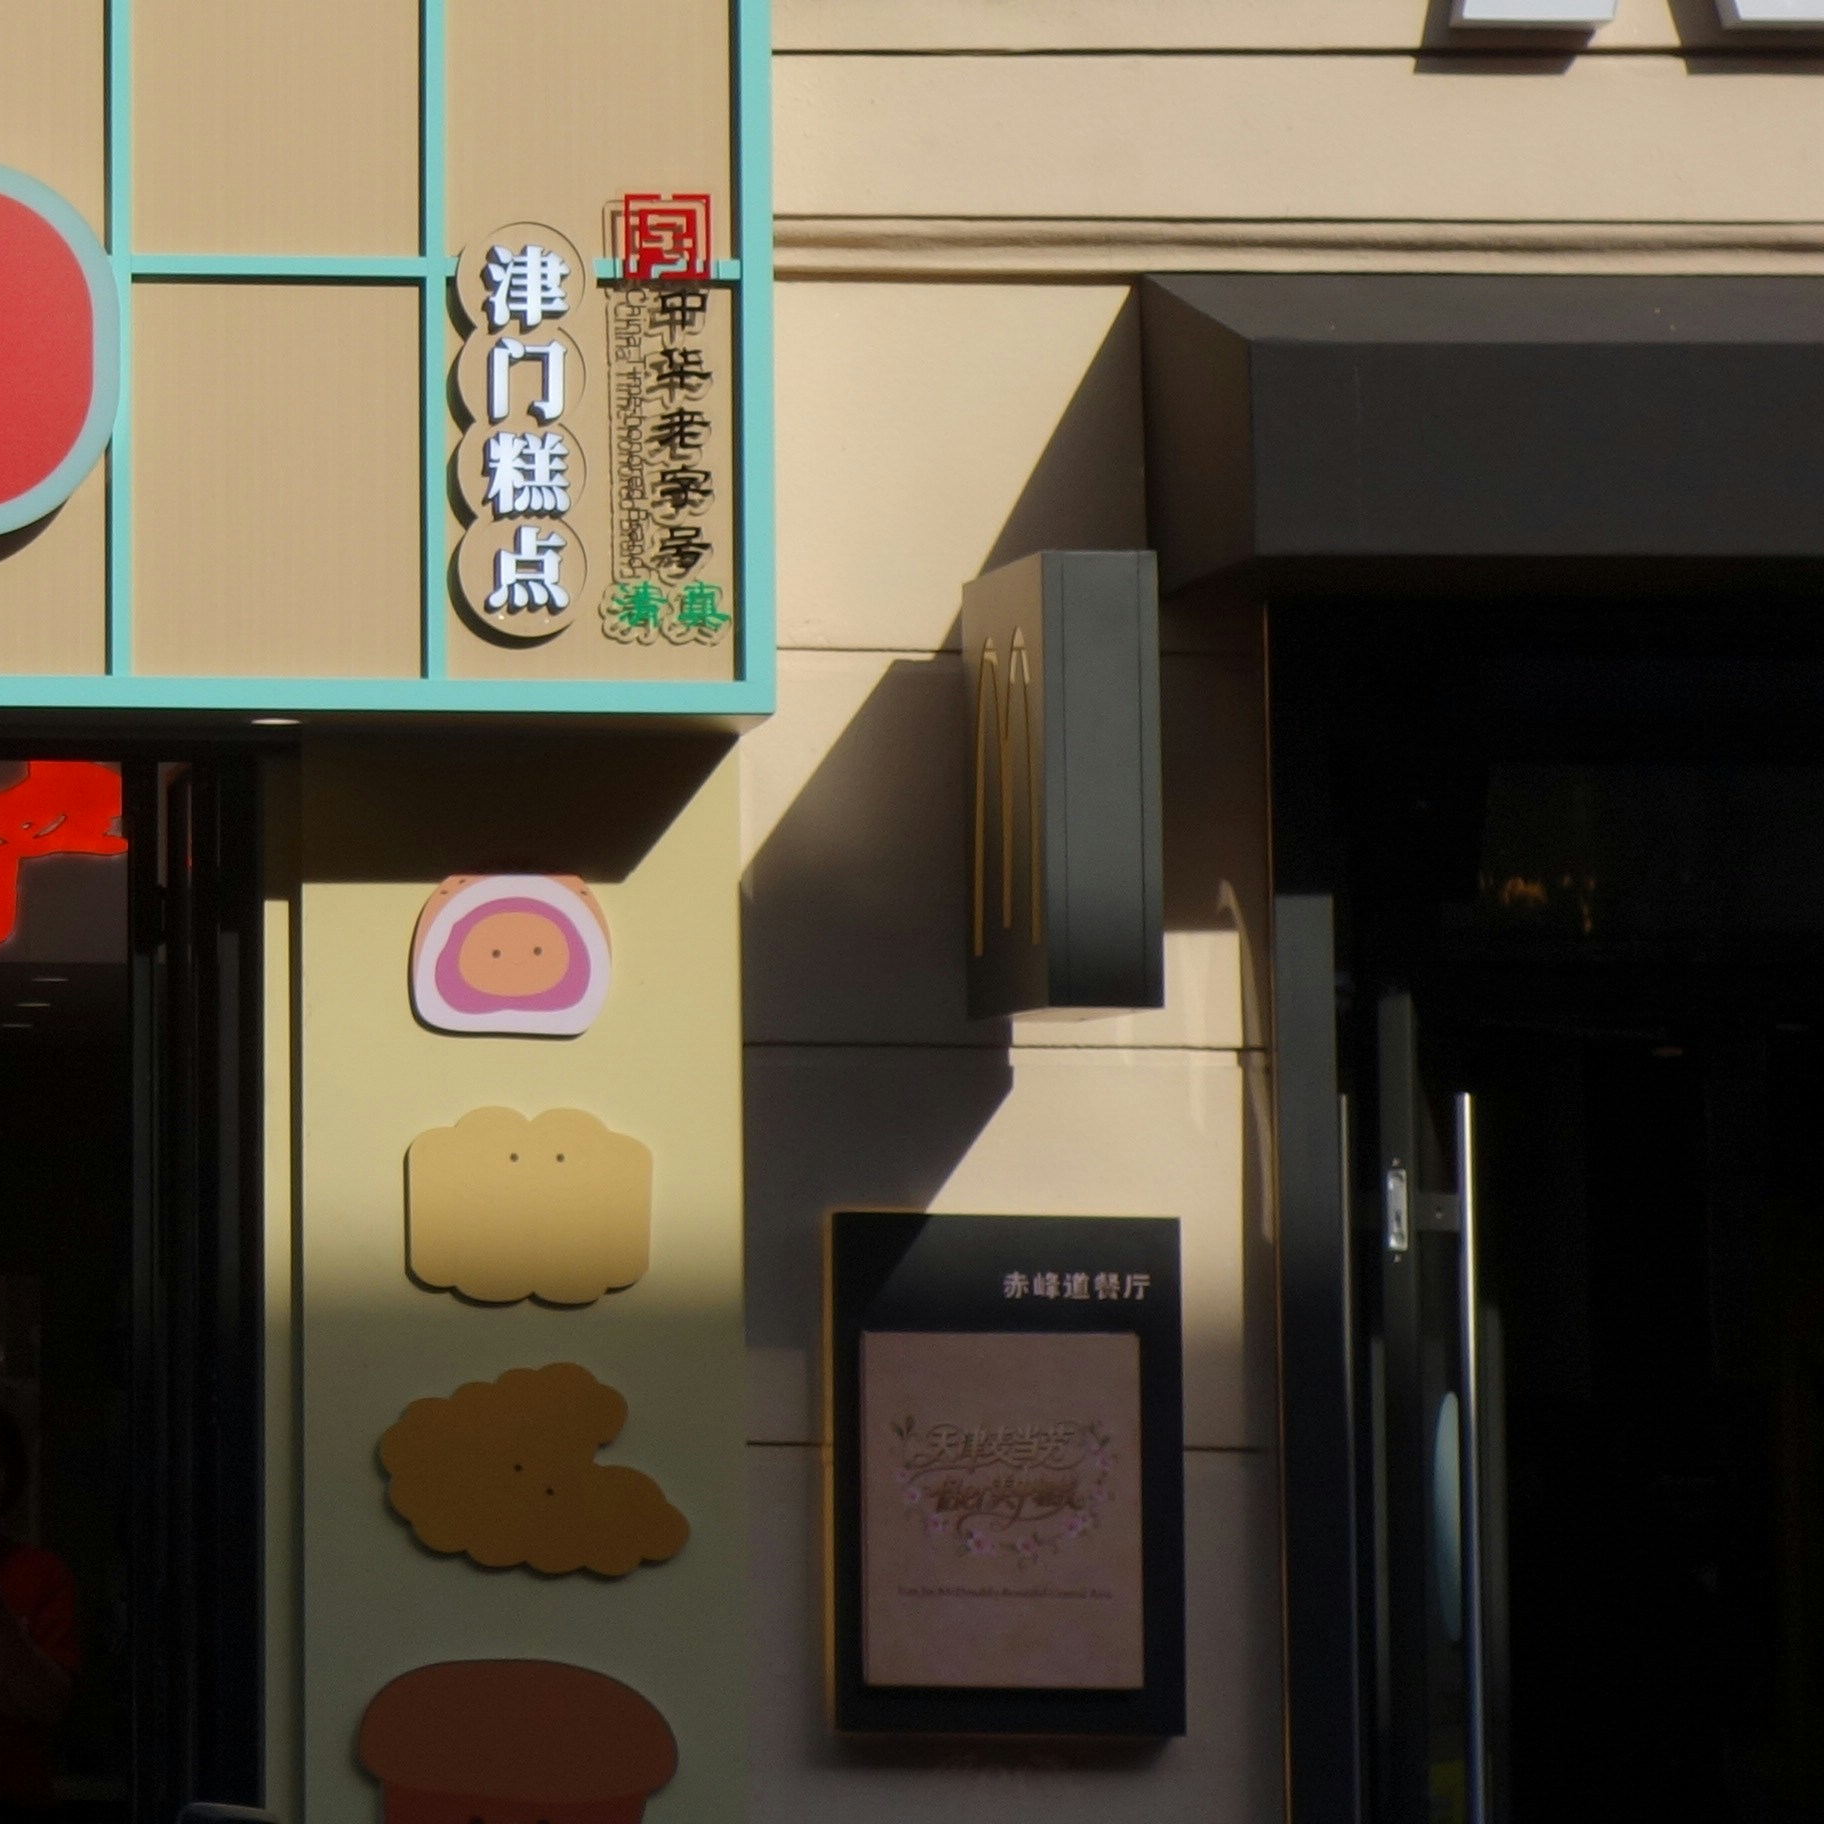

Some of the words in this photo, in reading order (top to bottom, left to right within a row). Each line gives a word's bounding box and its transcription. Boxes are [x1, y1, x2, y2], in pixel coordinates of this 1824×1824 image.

[484, 243, 572, 614] 津门糕点
[659, 288, 713, 571] 中华老字号
[614, 580, 731, 633] 清真
[1002, 1271, 1152, 1301] 赤峰道餐厅
